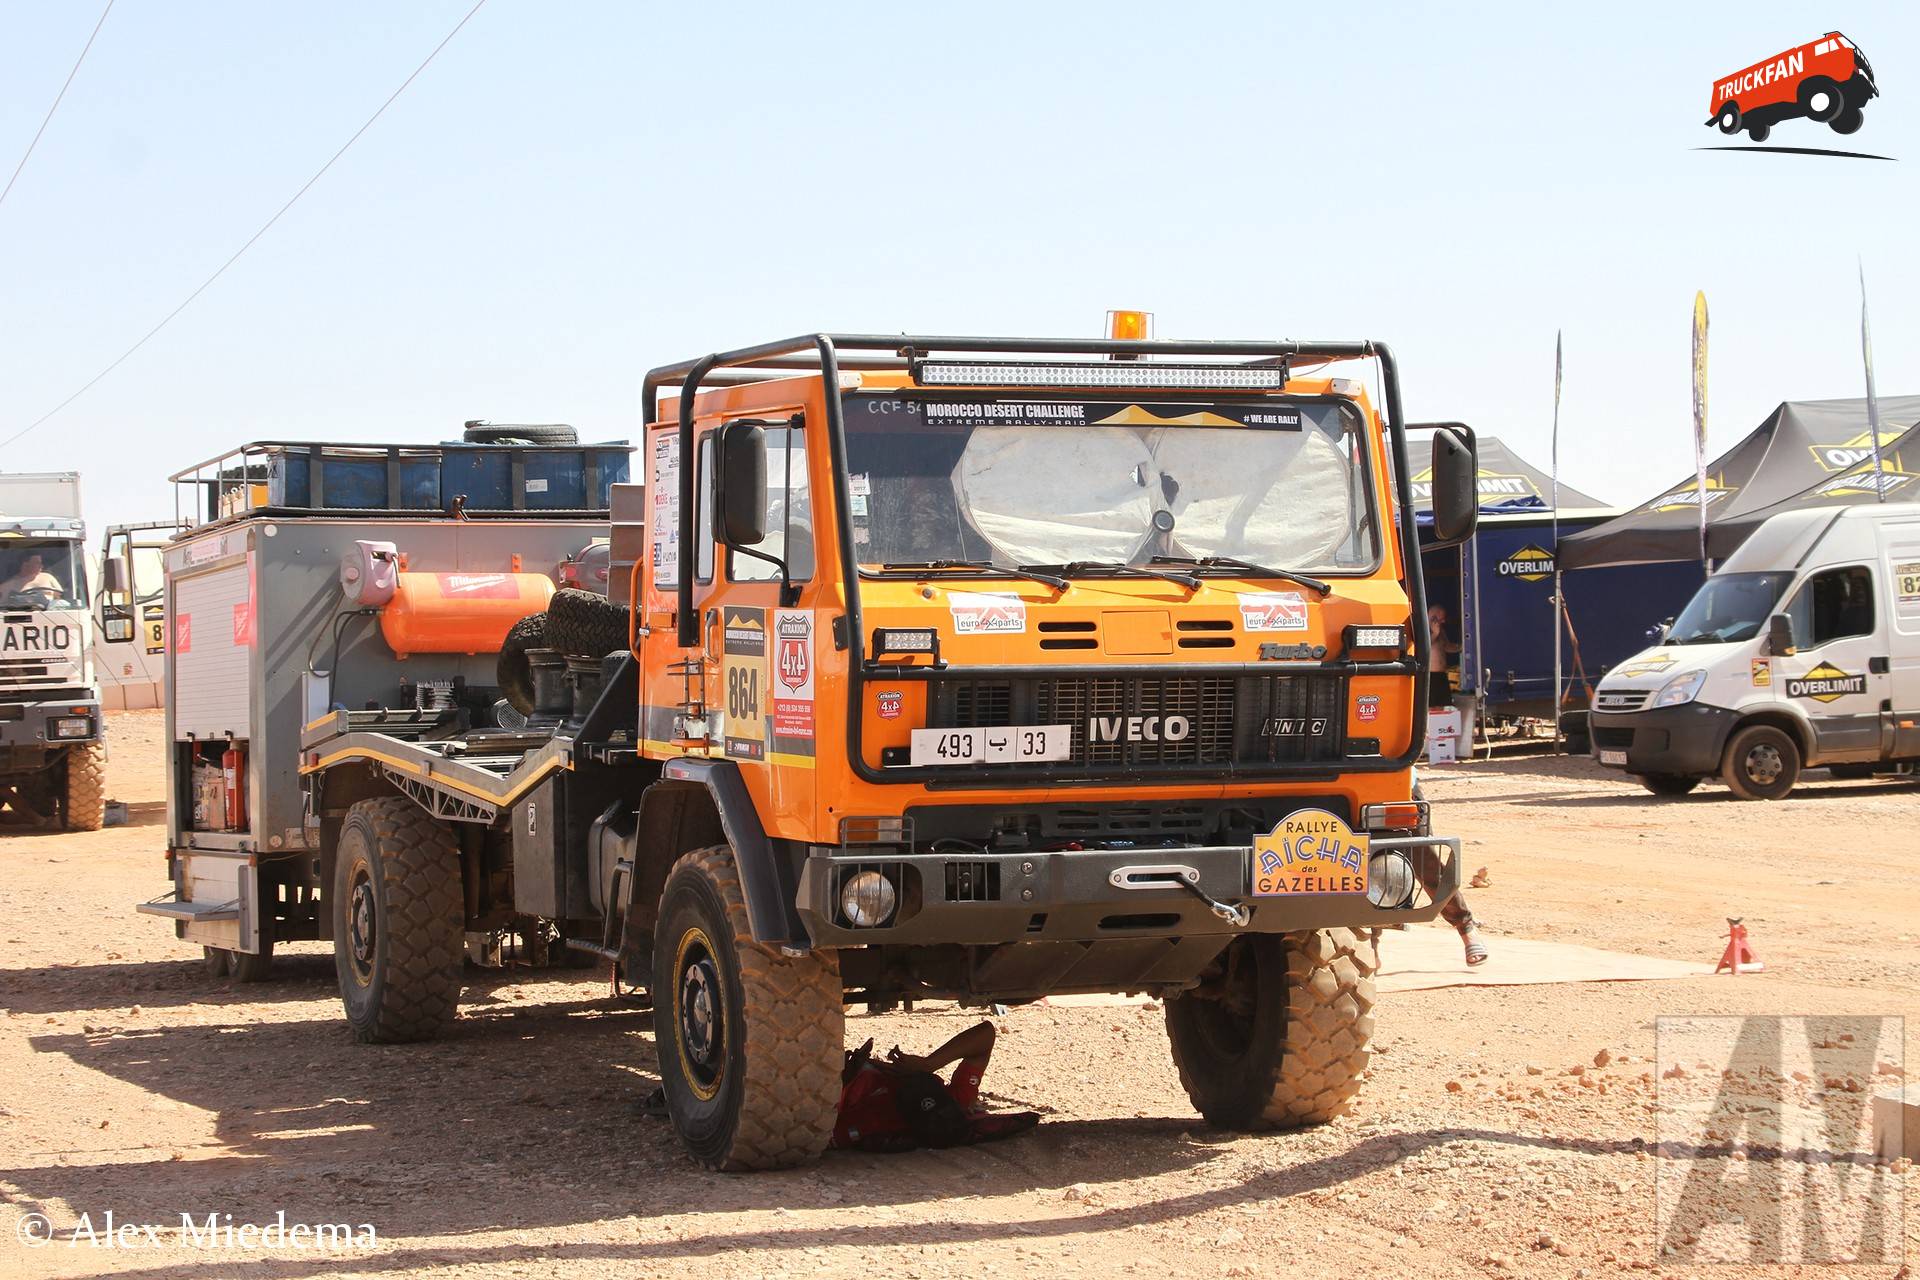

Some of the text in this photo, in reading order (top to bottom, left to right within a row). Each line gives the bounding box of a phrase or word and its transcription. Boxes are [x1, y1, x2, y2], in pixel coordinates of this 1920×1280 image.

[926, 403, 1085, 418] MOROCCO DESERT CHALLENGE
[1263, 415, 1277, 424] ARE
[1278, 415, 1298, 425] RALLY
[153, 624, 164, 641] 8
[781, 623, 807, 634] ATRAXION
[3, 625, 69, 651] ARIO
[1259, 642, 1328, 660] Turbo
[729, 666, 758, 721] 864
[1790, 677, 1863, 696] OVERLIMIT
[1089, 715, 1190, 742] IVECO
[937, 732, 1046, 758] 493 ب 33
[1286, 821, 1338, 833] RALLYE
[1301, 864, 1318, 873] des
[1258, 876, 1364, 893] GAZELLES
